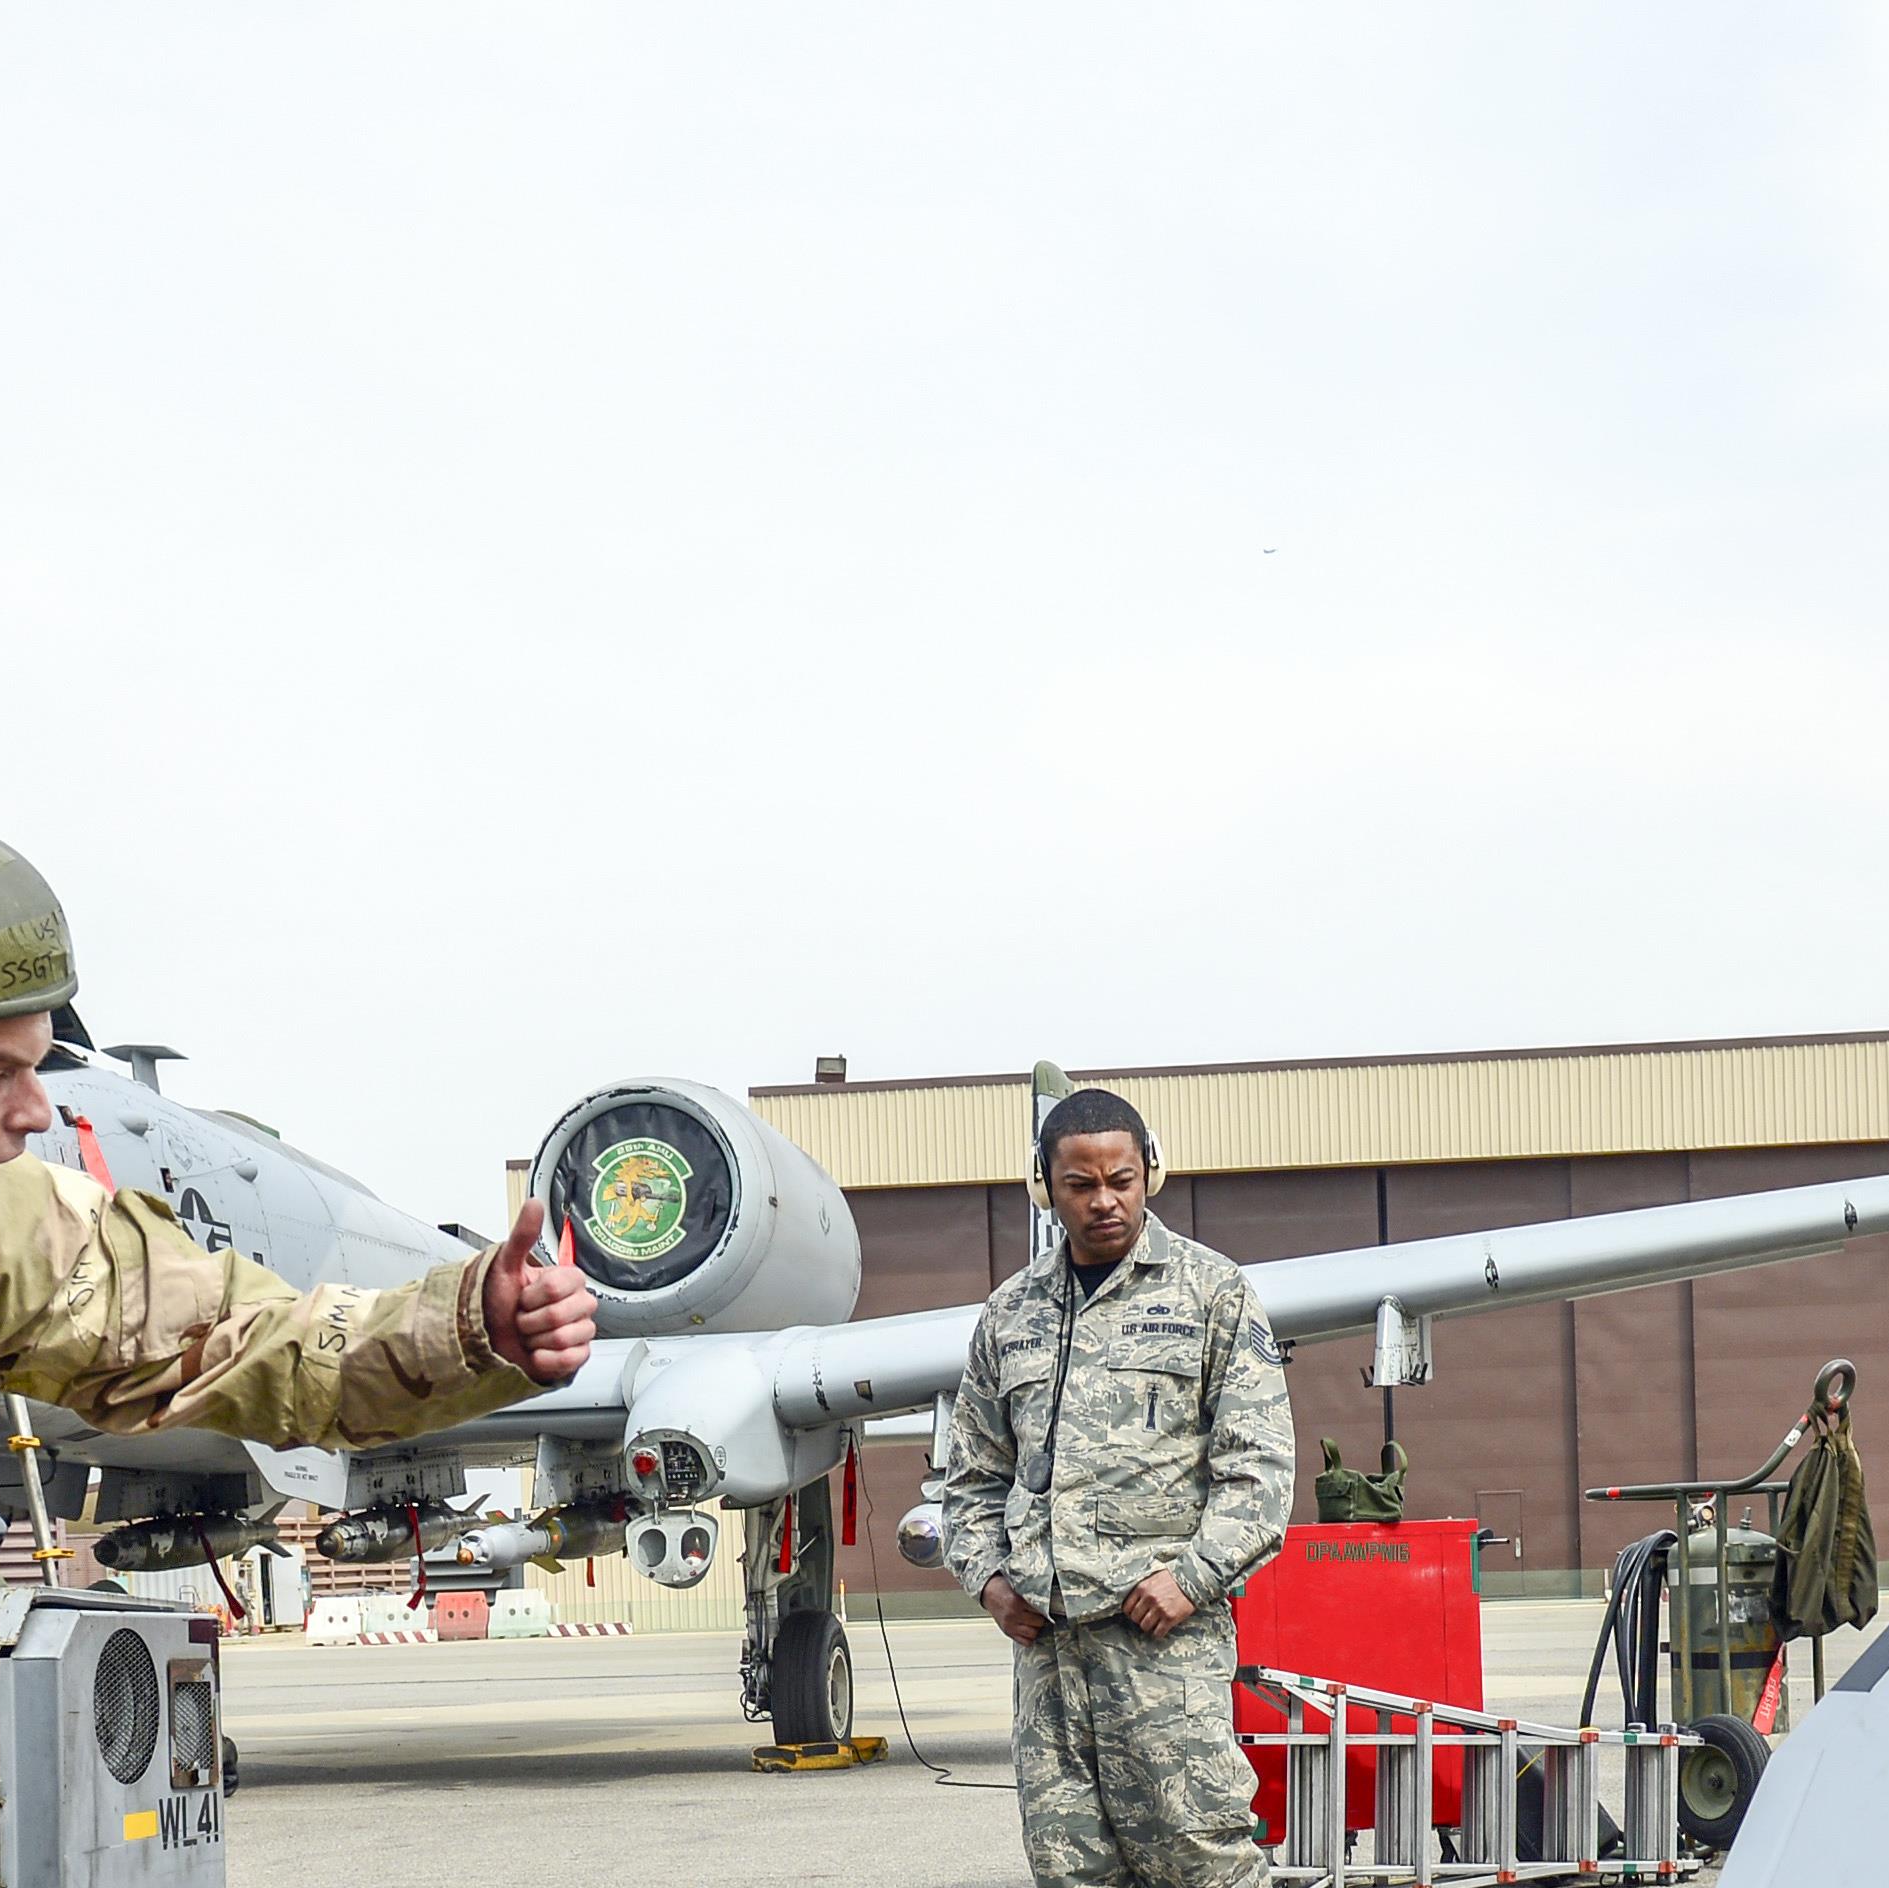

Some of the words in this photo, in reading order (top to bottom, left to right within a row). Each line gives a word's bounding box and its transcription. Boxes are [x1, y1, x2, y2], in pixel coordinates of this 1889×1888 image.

[1, 951, 54, 989] SSGT
[647, 1143, 674, 1160] AMU
[641, 1236, 675, 1256] MAINT
[1141, 1323, 1160, 1334] AIR
[1162, 1323, 1197, 1338] FORCE
